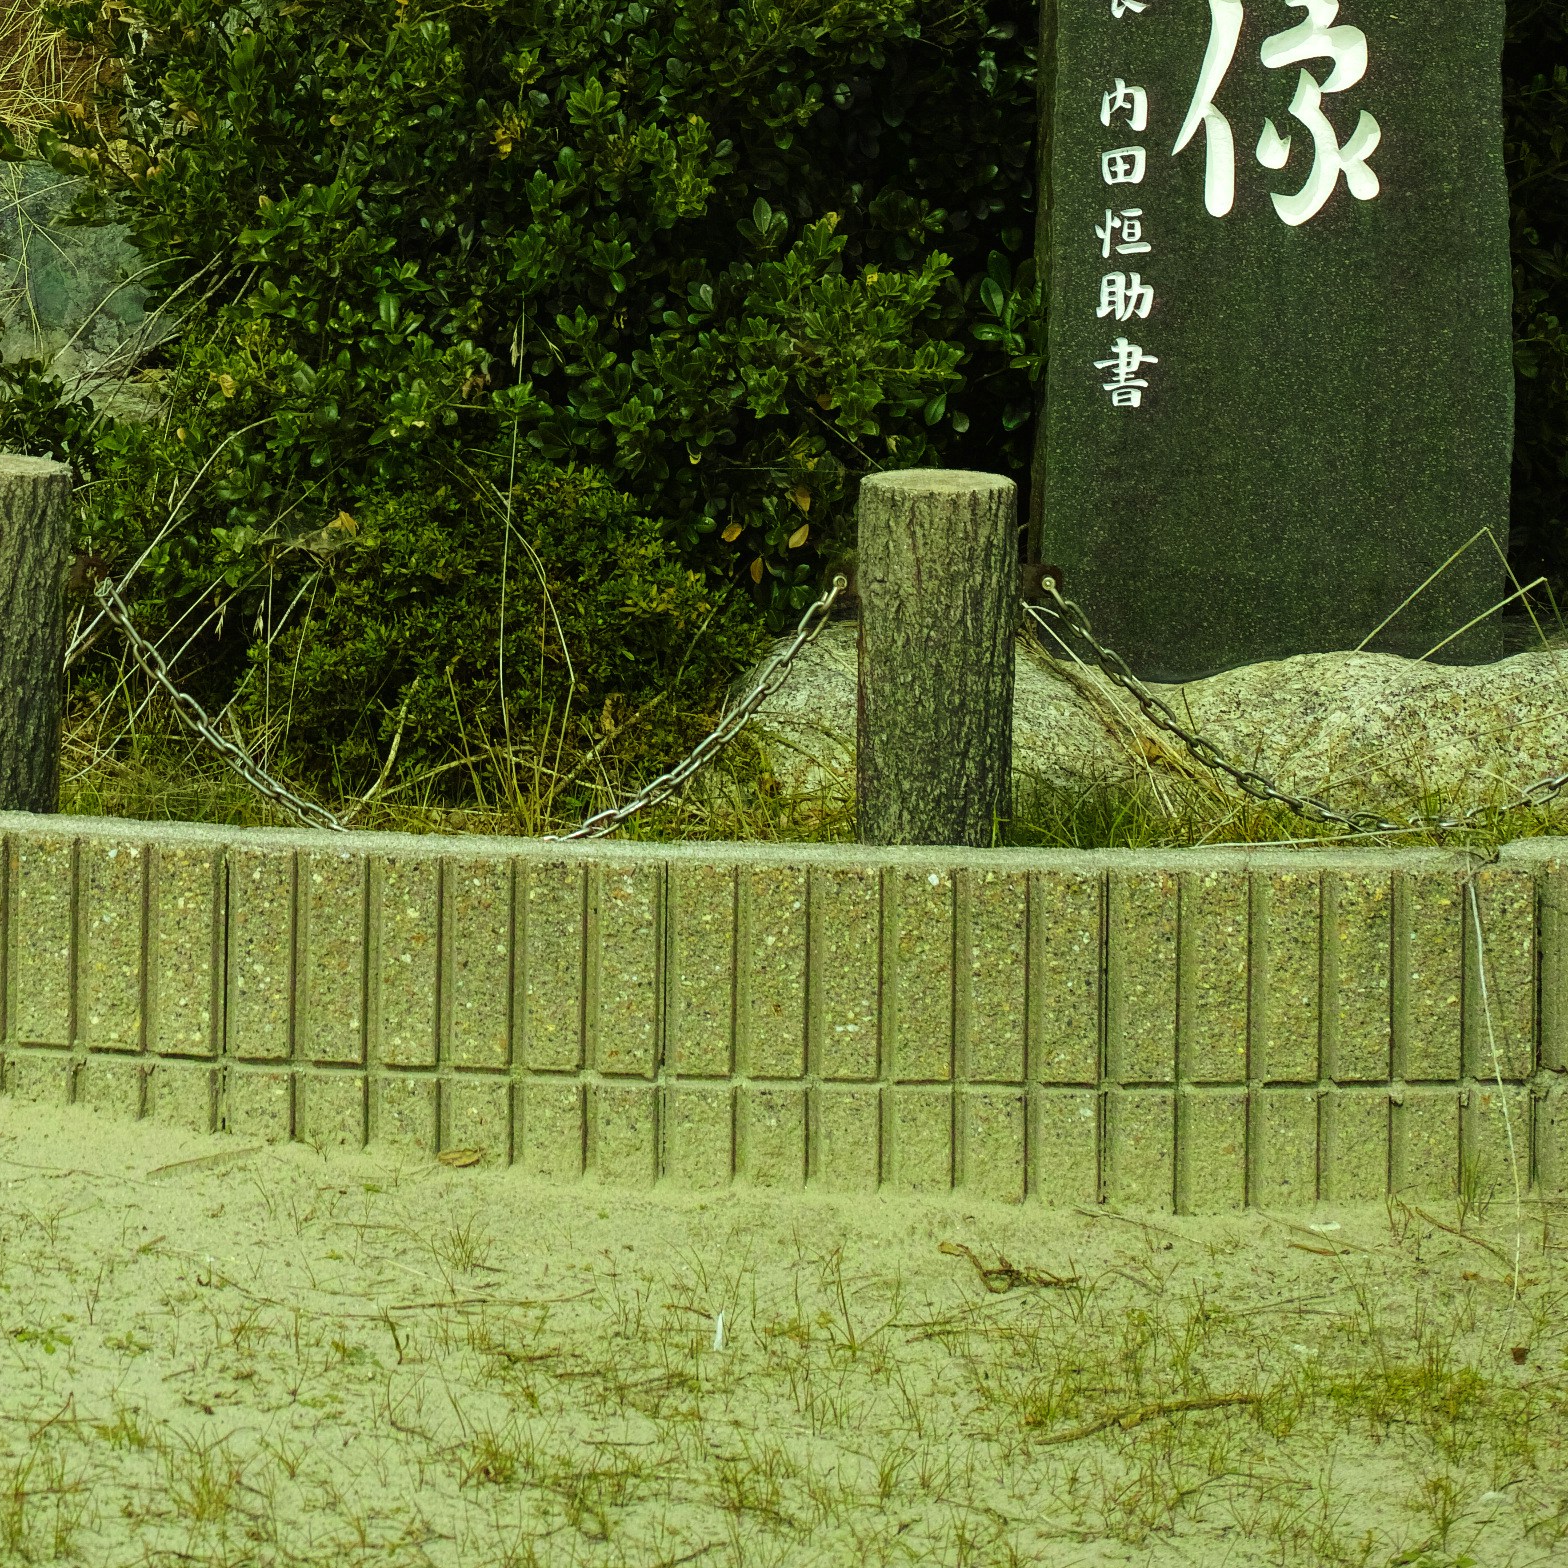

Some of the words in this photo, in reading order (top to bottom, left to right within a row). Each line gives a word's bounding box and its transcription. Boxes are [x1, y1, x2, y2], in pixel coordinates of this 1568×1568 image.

[1093, 76, 1160, 409] 内田恒助書
